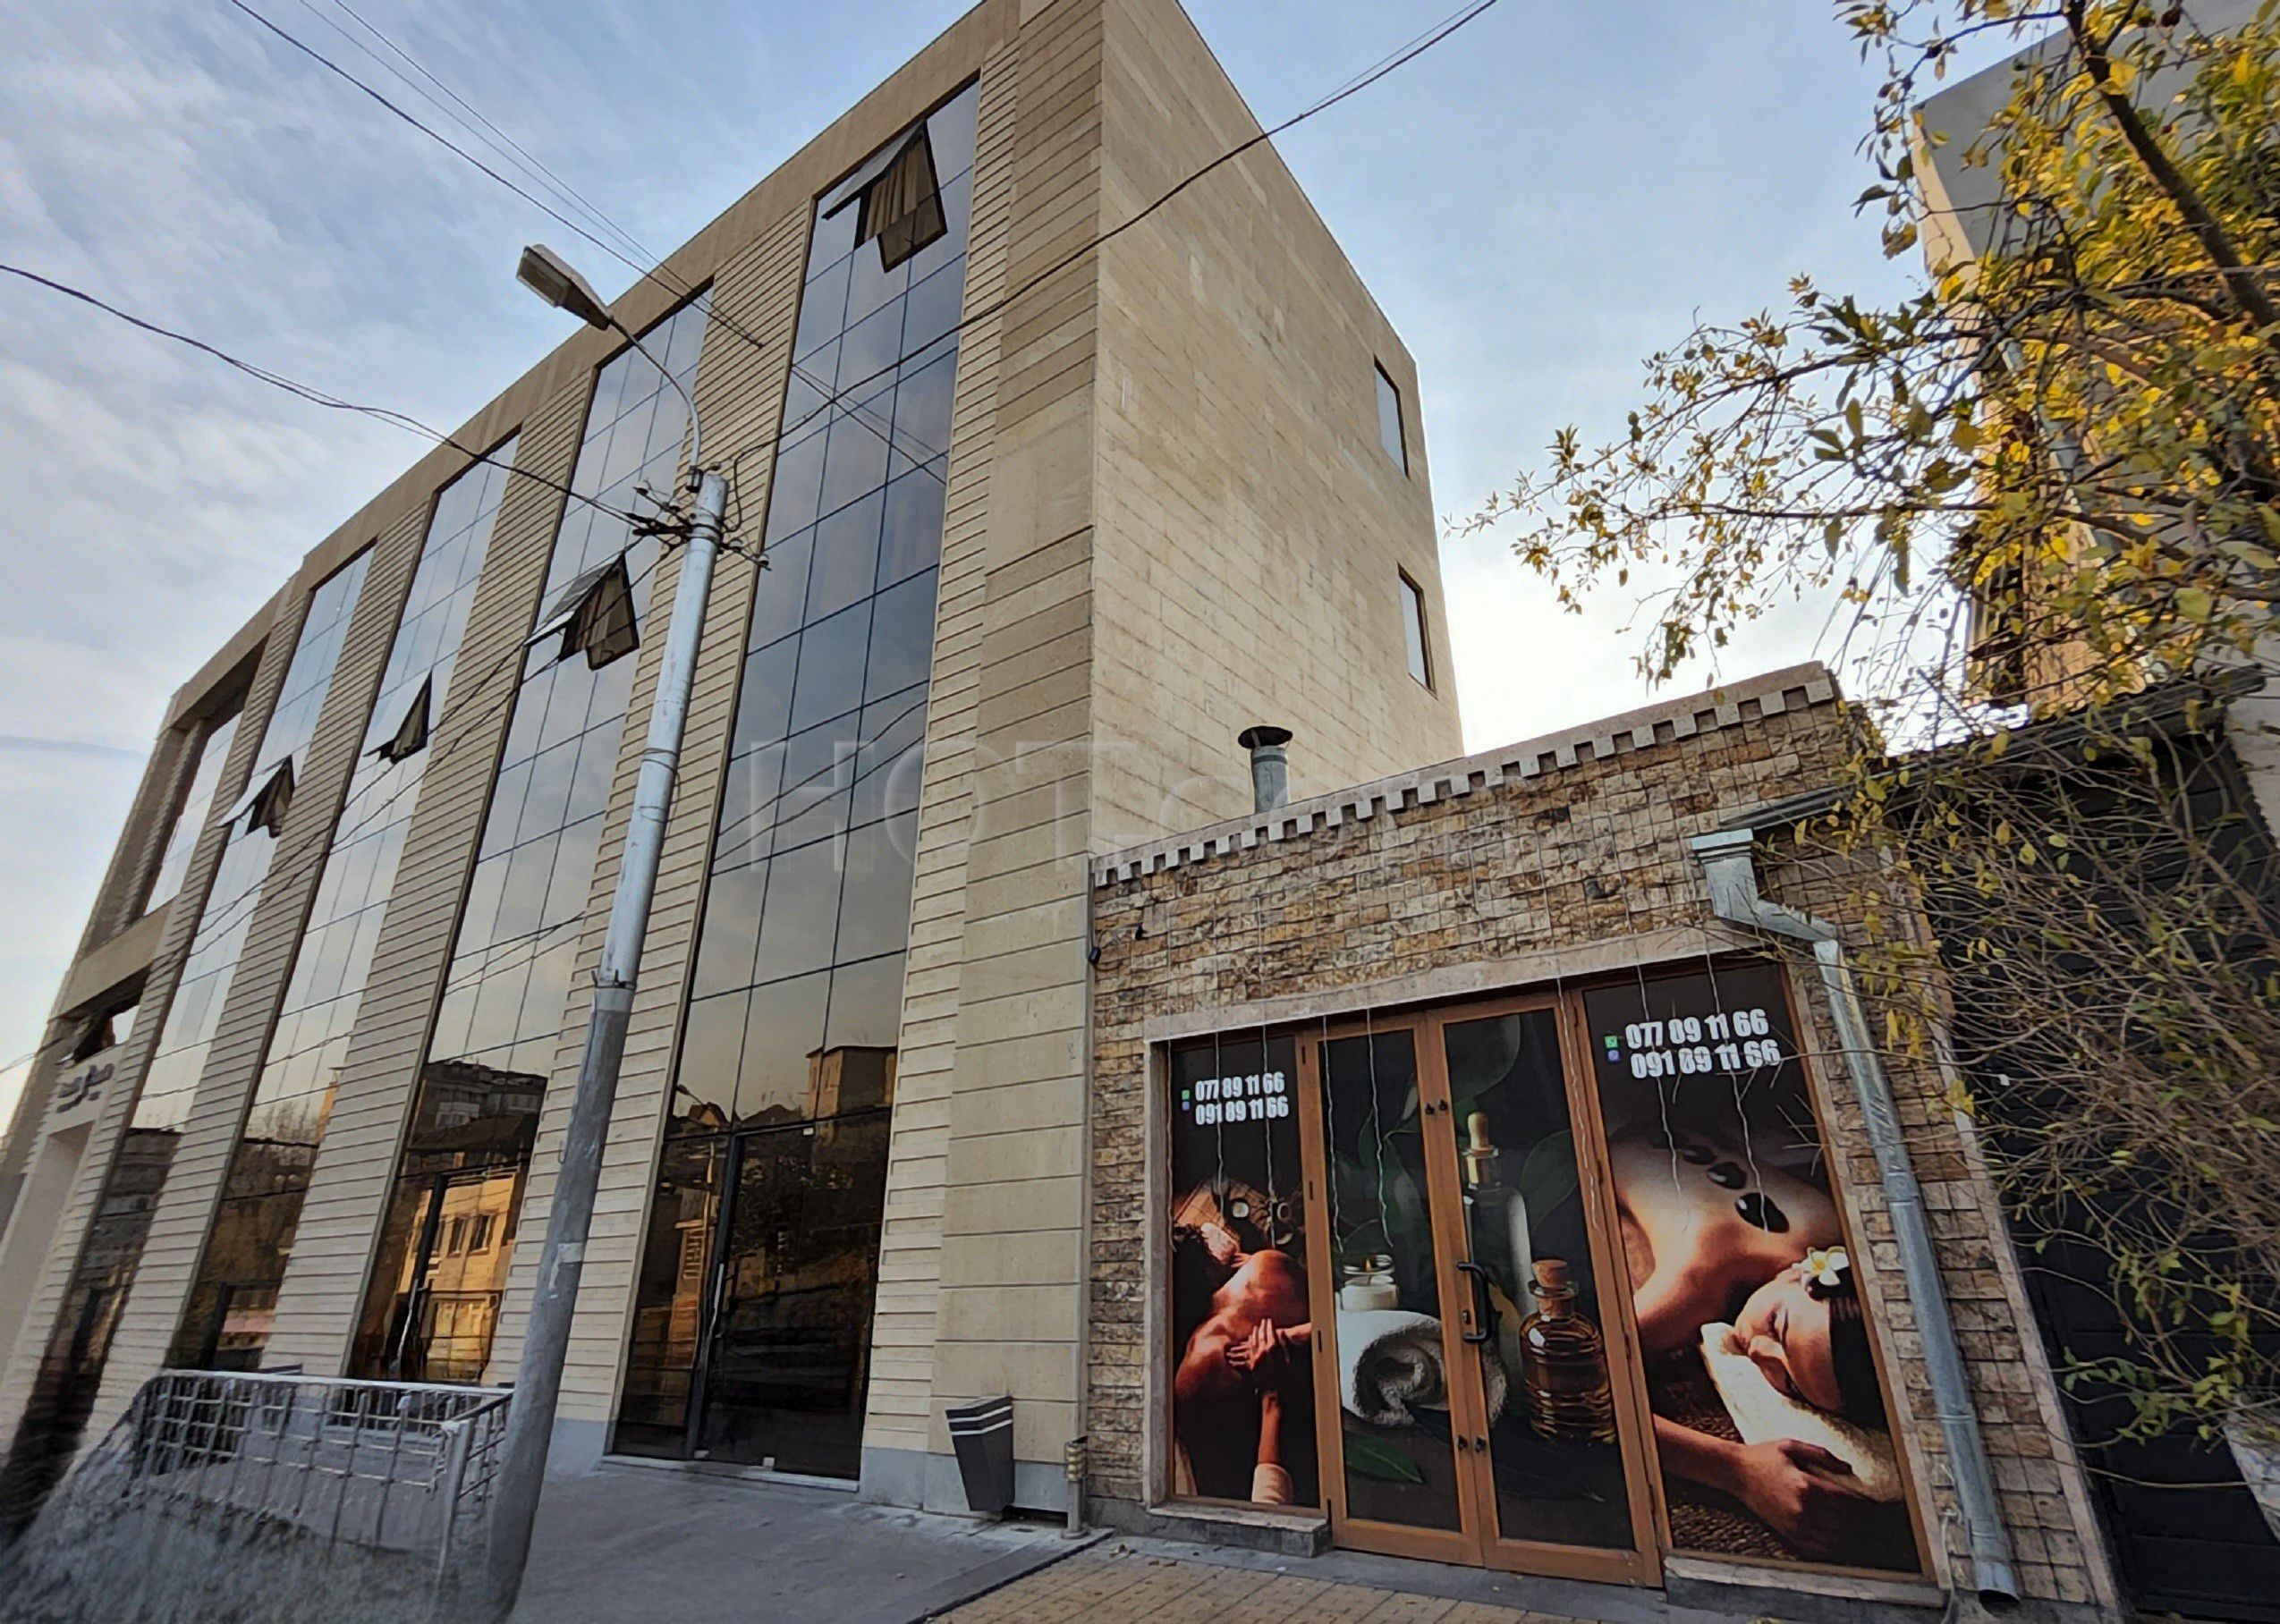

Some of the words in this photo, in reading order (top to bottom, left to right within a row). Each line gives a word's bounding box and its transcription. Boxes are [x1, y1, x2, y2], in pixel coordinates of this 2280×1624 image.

[1625, 1021, 1663, 1049] 077
[1668, 1017, 1702, 1045] 89
[1704, 1012, 1730, 1040] 11
[1733, 1009, 1769, 1037] 66
[1631, 1050, 1675, 1078] 091
[1678, 1046, 1713, 1074] 89
[1715, 1043, 1741, 1070] 11
[1195, 1079, 1219, 1101] 077
[1222, 1076, 1243, 1098] 89
[1245, 1074, 1260, 1095] 11
[1262, 1071, 1285, 1094] 66
[1195, 1104, 1223, 1125] 091
[1225, 1100, 1247, 1122] 89
[1249, 1098, 1264, 1120] 11
[1267, 1095, 1289, 1118] 66
